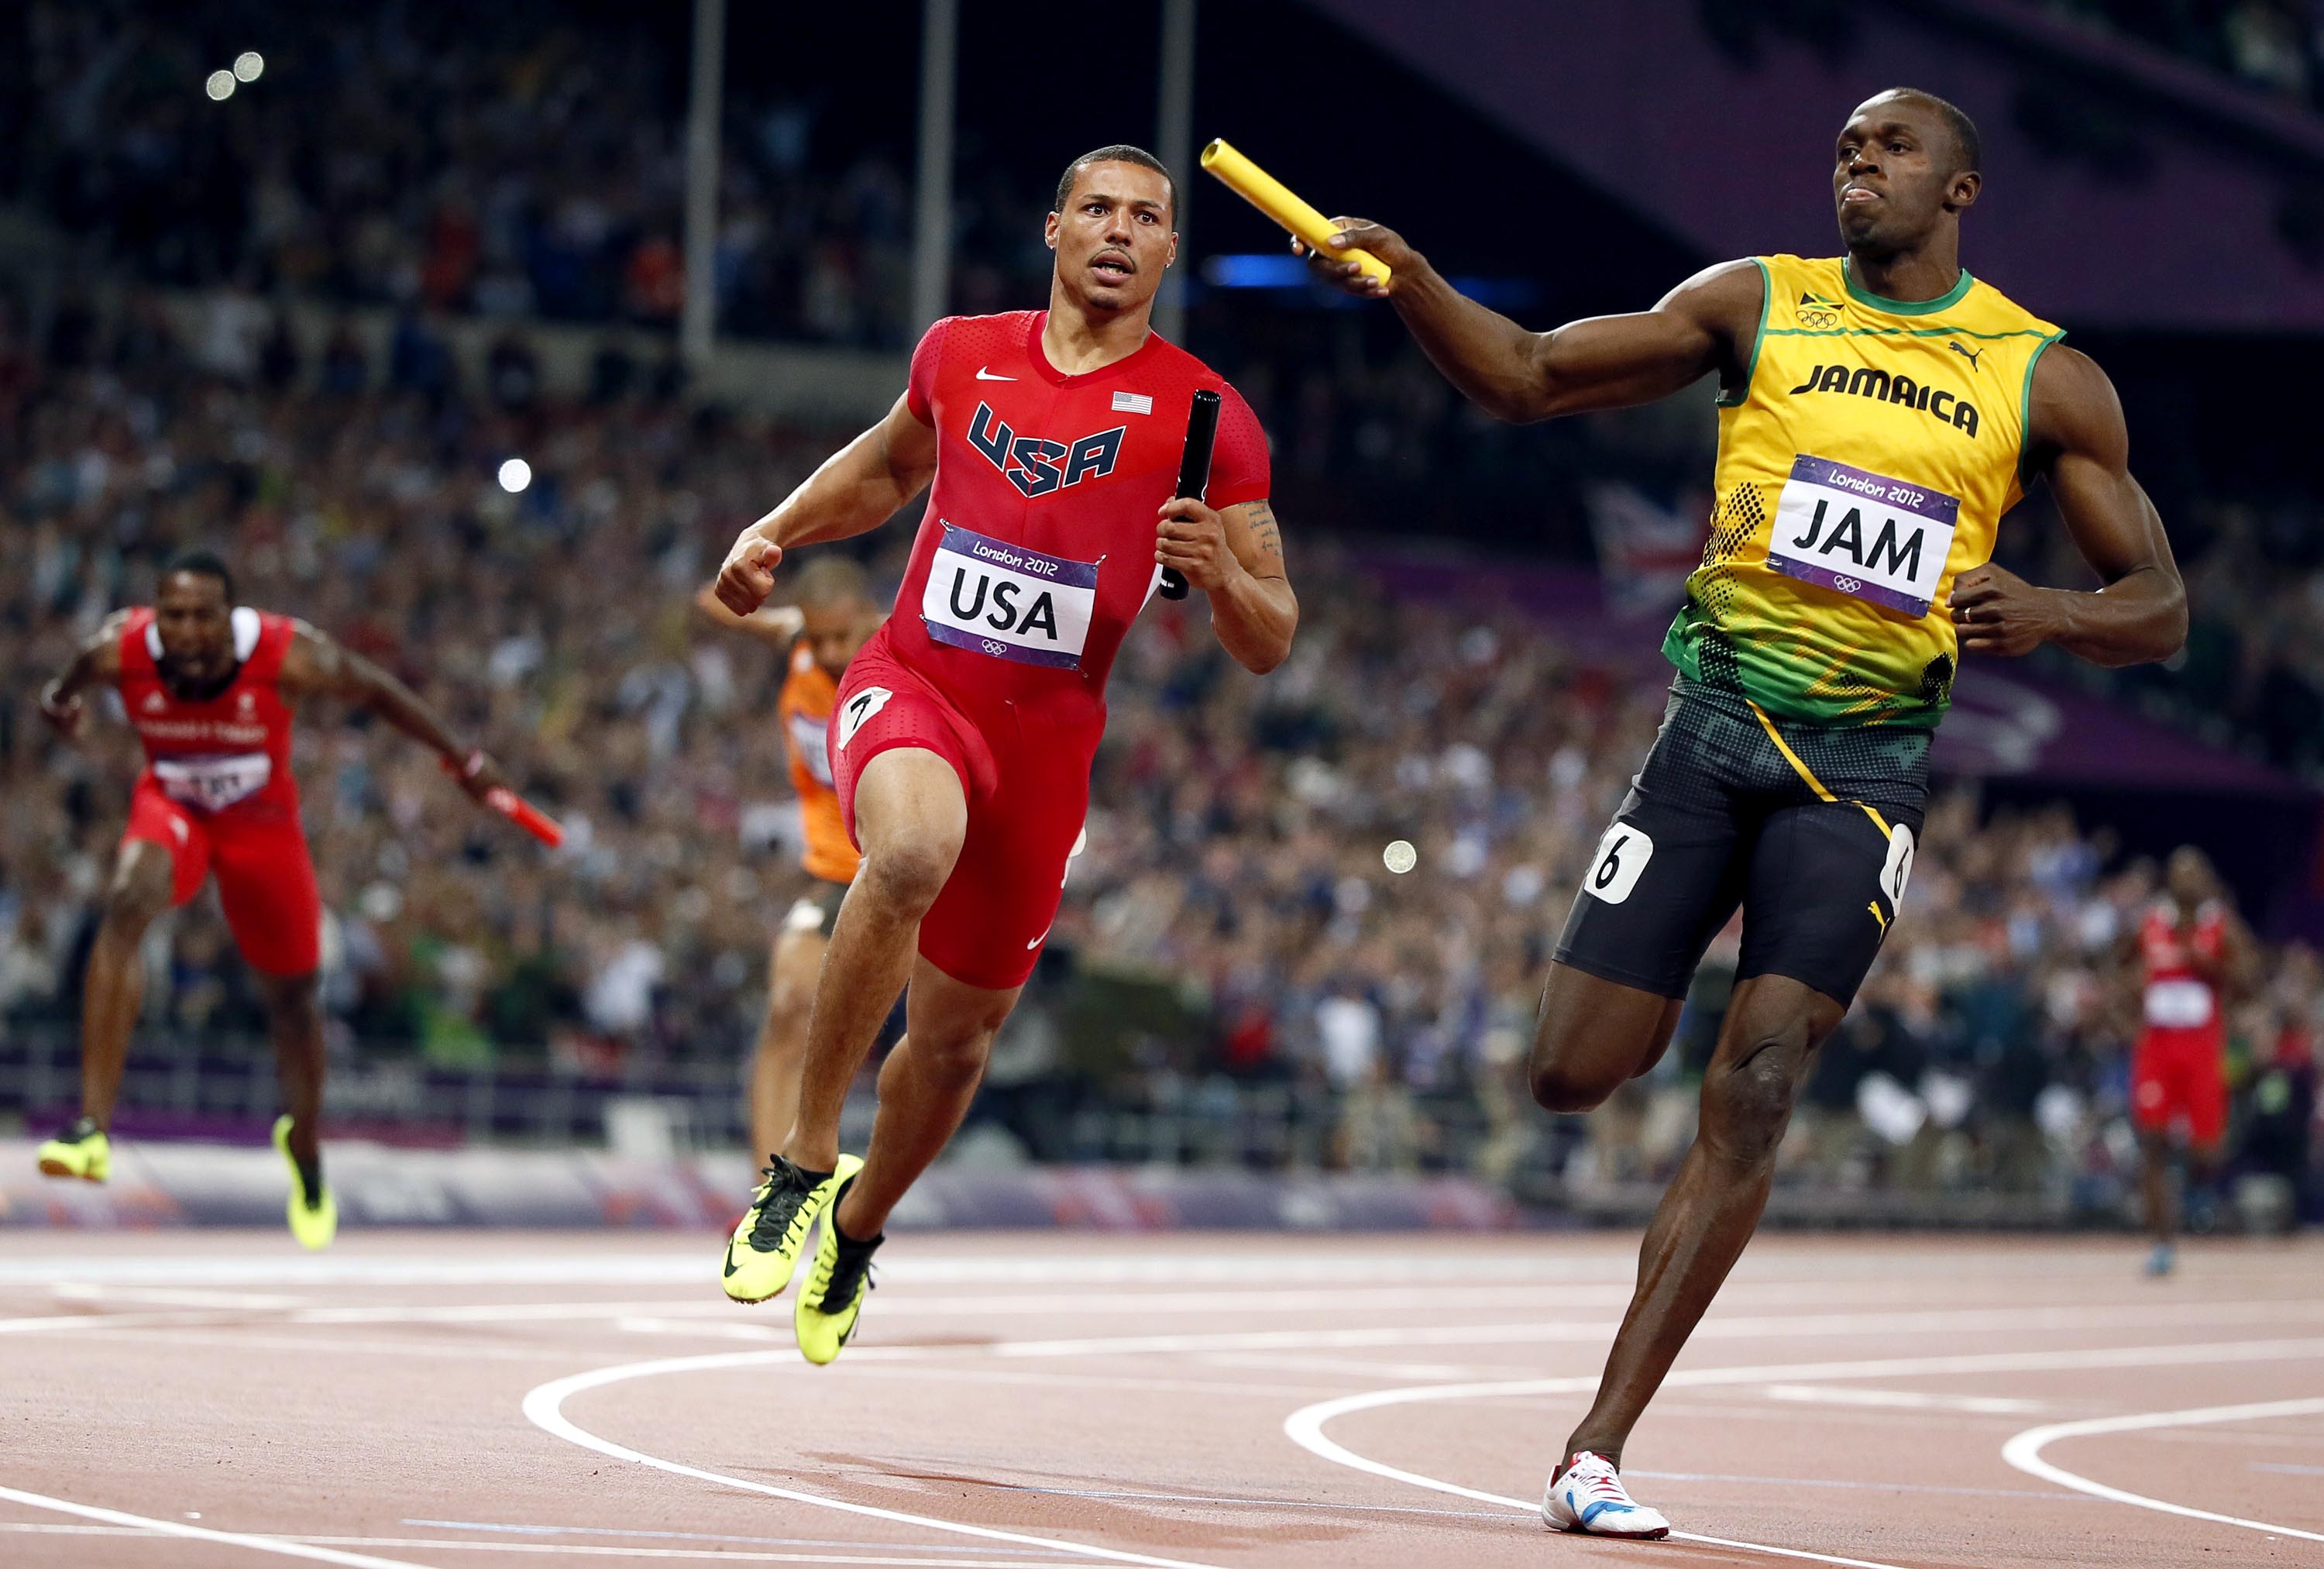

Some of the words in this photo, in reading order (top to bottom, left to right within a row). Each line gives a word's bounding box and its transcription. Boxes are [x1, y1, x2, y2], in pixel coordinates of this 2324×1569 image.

[1789, 365, 1979, 439] JAMAICA
[967, 400, 1127, 498] USA
[1828, 469, 1886, 497] London
[1887, 487, 1924, 508] 2012
[972, 541, 1023, 567] London
[1024, 557, 1059, 576] 2012
[1793, 499, 1924, 582] JAM
[950, 567, 1057, 641] USA
[850, 693, 872, 731] 7
[1595, 834, 1630, 890] 6
[1893, 845, 1910, 900] 6
